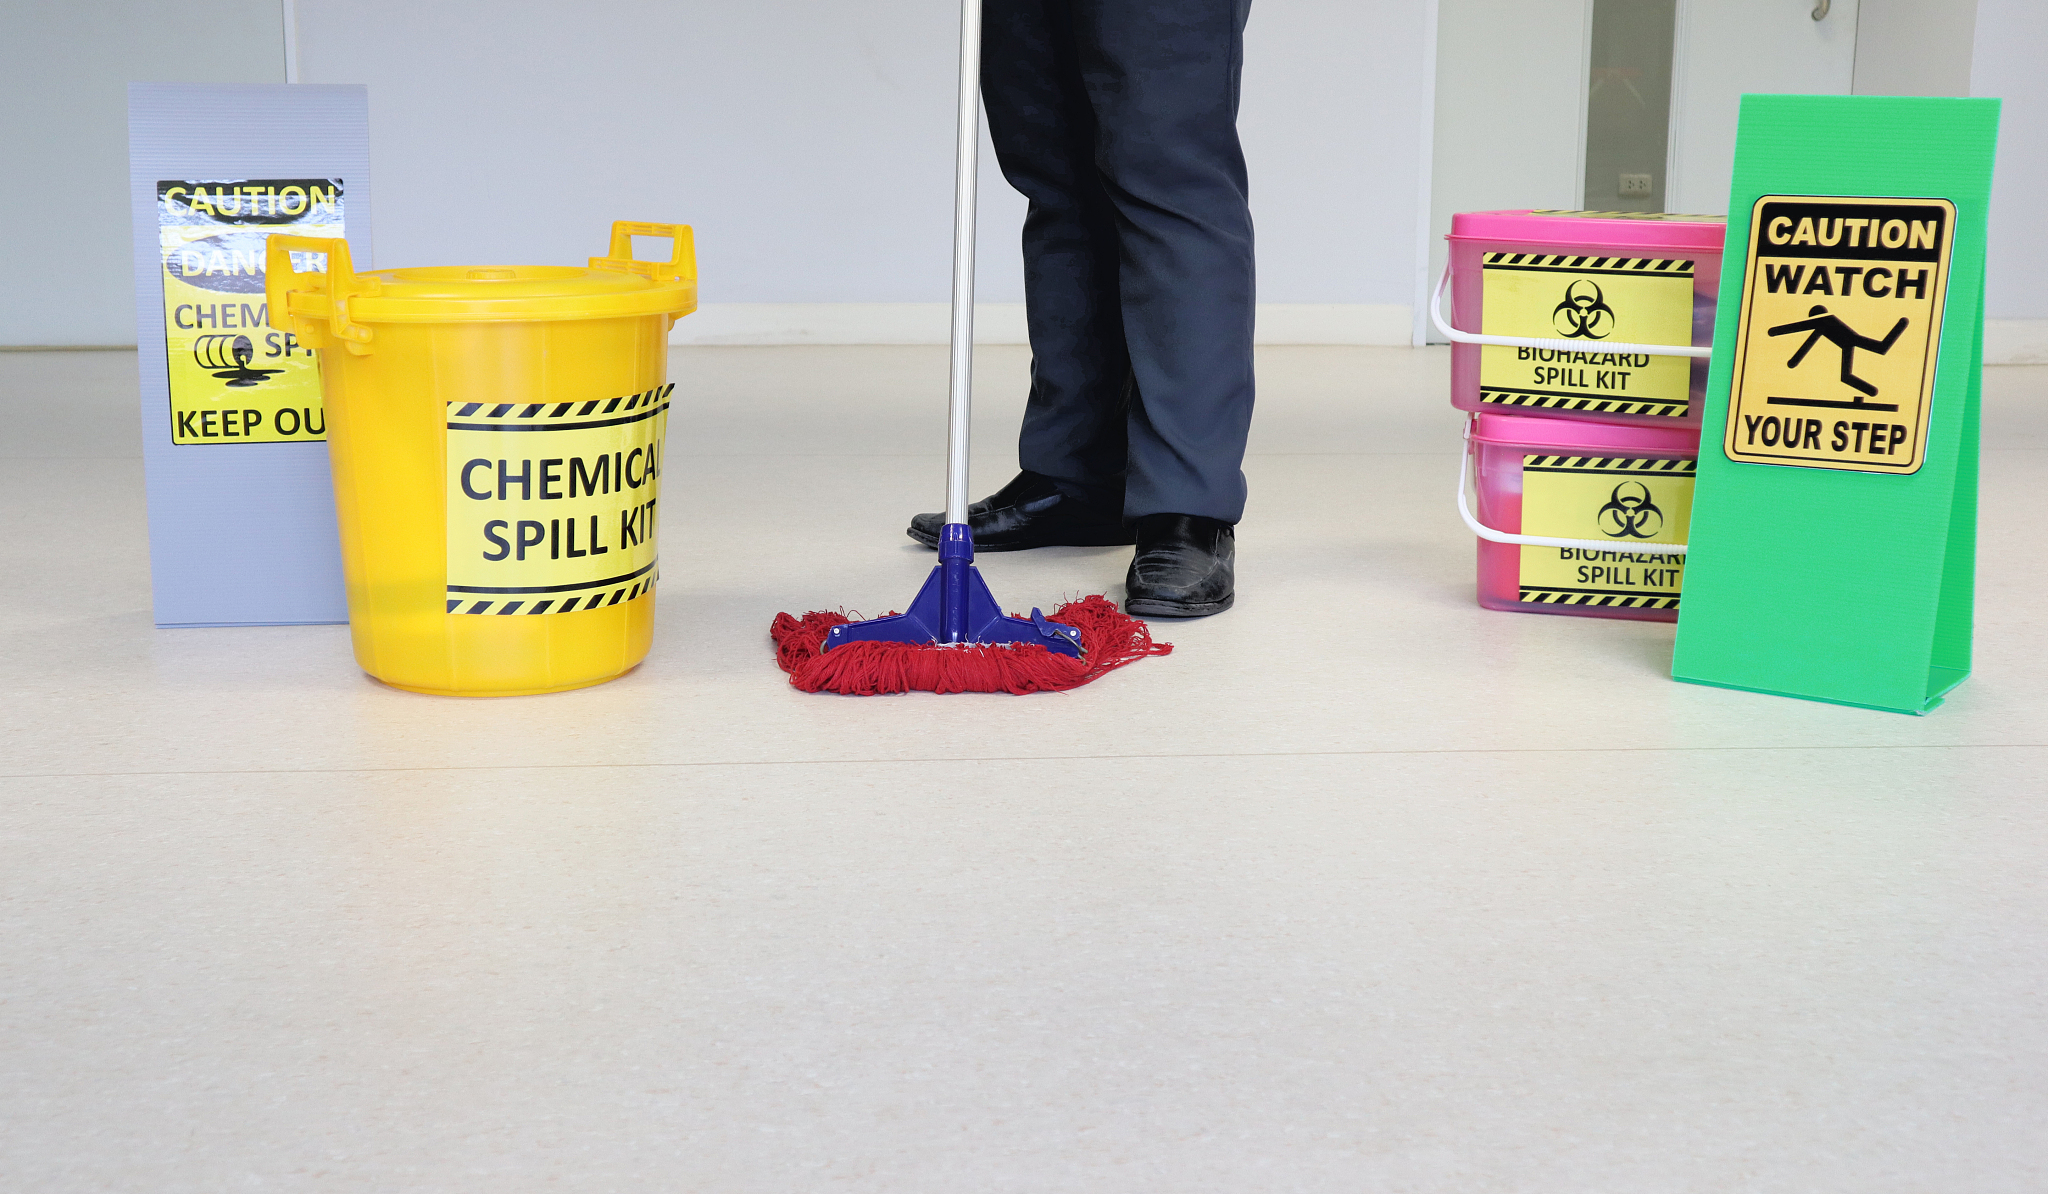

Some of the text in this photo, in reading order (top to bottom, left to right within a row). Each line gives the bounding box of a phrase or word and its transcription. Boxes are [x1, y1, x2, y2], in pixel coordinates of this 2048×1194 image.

[164, 185, 336, 217] CAUTION
[1767, 215, 1938, 250] CAUTION
[1765, 263, 1929, 300] WATCH
[174, 302, 270, 330] CHEM
[1533, 365, 1631, 391] SPILL KIT
[177, 407, 326, 438] KEEP OU
[1744, 414, 1908, 456] YOUR STEP
[460, 438, 661, 501] CHEMICAL
[482, 497, 657, 562] SPILL KIT
[1560, 547, 1687, 565] BIOHAZAR
[1577, 565, 1680, 588] SPILL KIT
